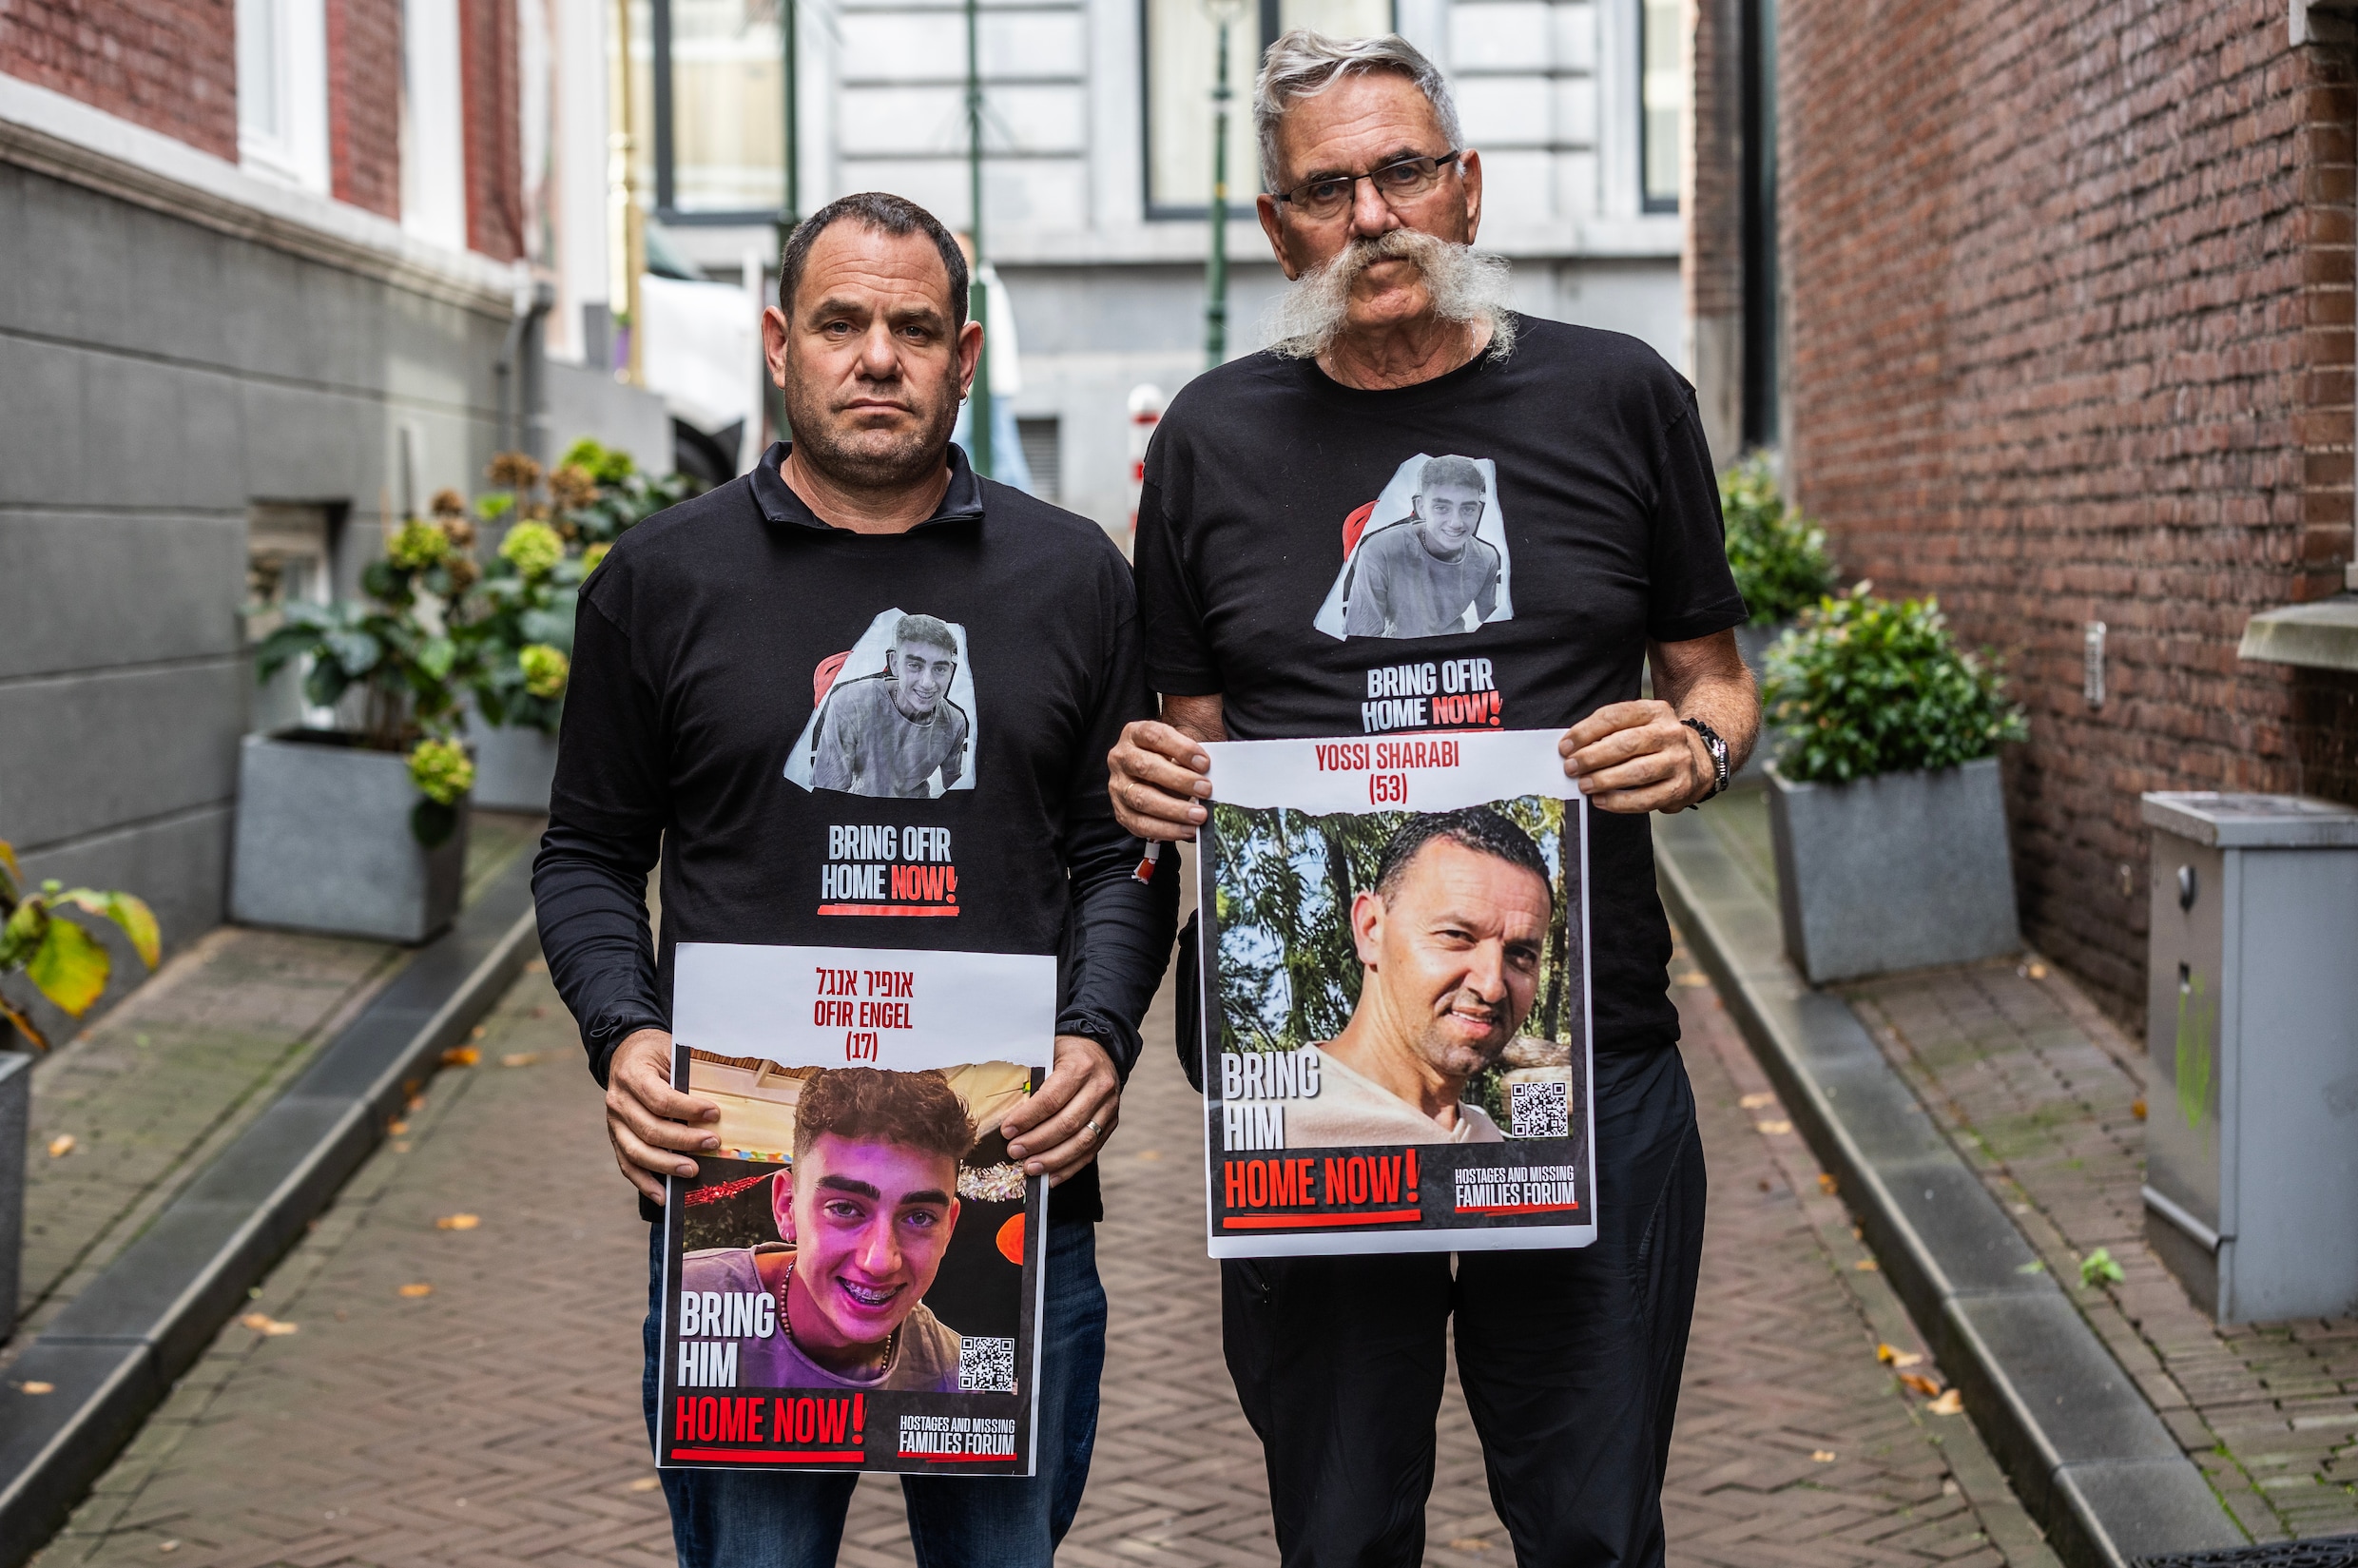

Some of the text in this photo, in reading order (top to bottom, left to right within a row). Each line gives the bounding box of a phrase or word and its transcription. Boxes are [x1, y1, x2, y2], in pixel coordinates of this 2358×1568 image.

[1367, 658, 1496, 699] BRING OFIR
[1362, 690, 1503, 733] HOME NOW!
[1315, 741, 1459, 771] YOSSI SHARABI
[1369, 772, 1407, 805] (53)
[829, 825, 952, 862] BRING OFIR
[821, 863, 958, 904] HOME NOW!
[816, 966, 914, 998] אופיר אנגל
[814, 999, 913, 1029] OFIR ENGEL
[845, 1031, 879, 1062] (17)
[1221, 1050, 1320, 1099] BRING
[1223, 1102, 1284, 1152] HIM
[1224, 1148, 1421, 1209] HOME NOW!
[1455, 1165, 1575, 1184] HOSTAGES AND MISSING
[1456, 1181, 1575, 1208] FAMILIES FORUM
[679, 1290, 776, 1338] BRING
[677, 1341, 739, 1387] HIM
[675, 1392, 868, 1445] HOME NOW!
[899, 1415, 1015, 1434] HOSTAGES AND MISSING
[899, 1430, 1015, 1456] FAMILIES FORUM
